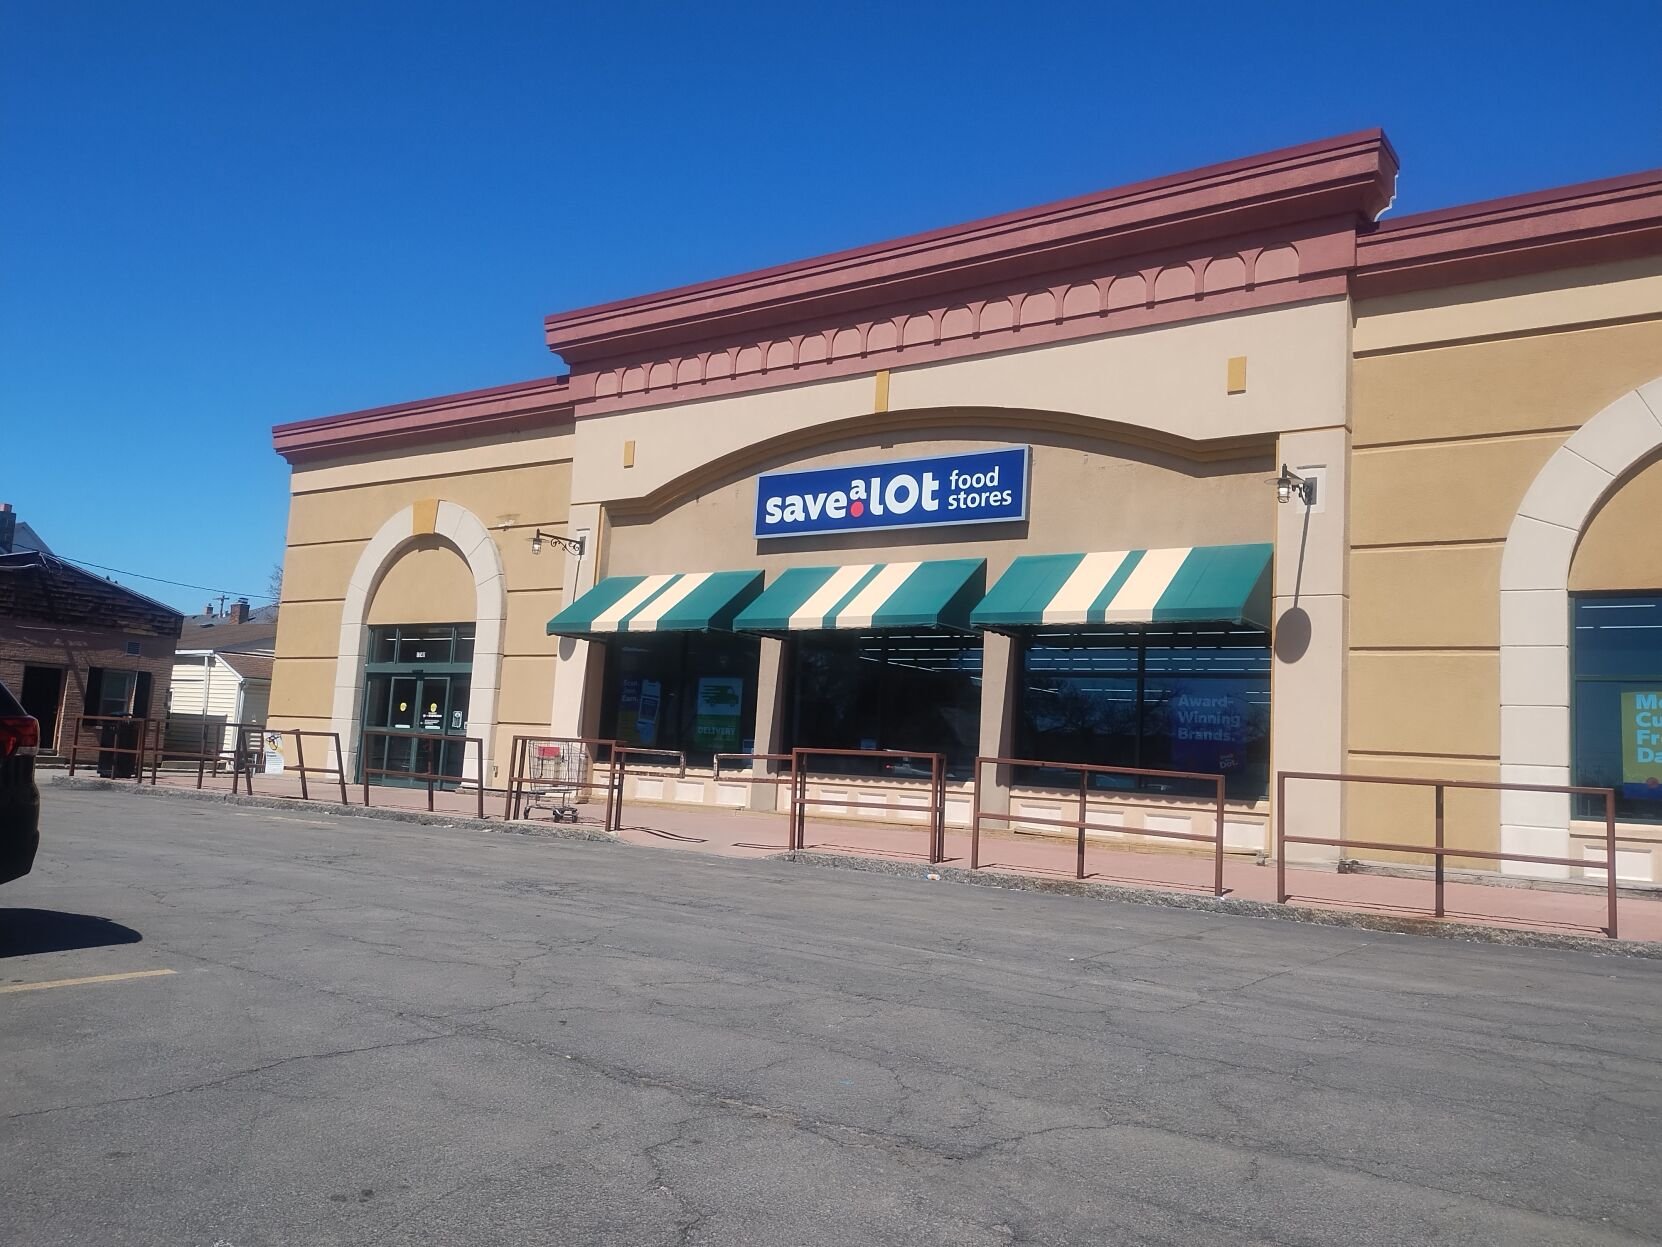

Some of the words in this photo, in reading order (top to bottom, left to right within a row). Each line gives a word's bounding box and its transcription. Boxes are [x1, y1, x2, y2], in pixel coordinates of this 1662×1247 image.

[949, 465, 999, 490] food
[765, 490, 847, 524] save
[948, 489, 1012, 510] stores
[1177, 694, 1235, 707] Award-
[1177, 710, 1241, 728] Winning
[697, 726, 736, 736] DELIVERY
[1177, 727, 1236, 741] Brands.
